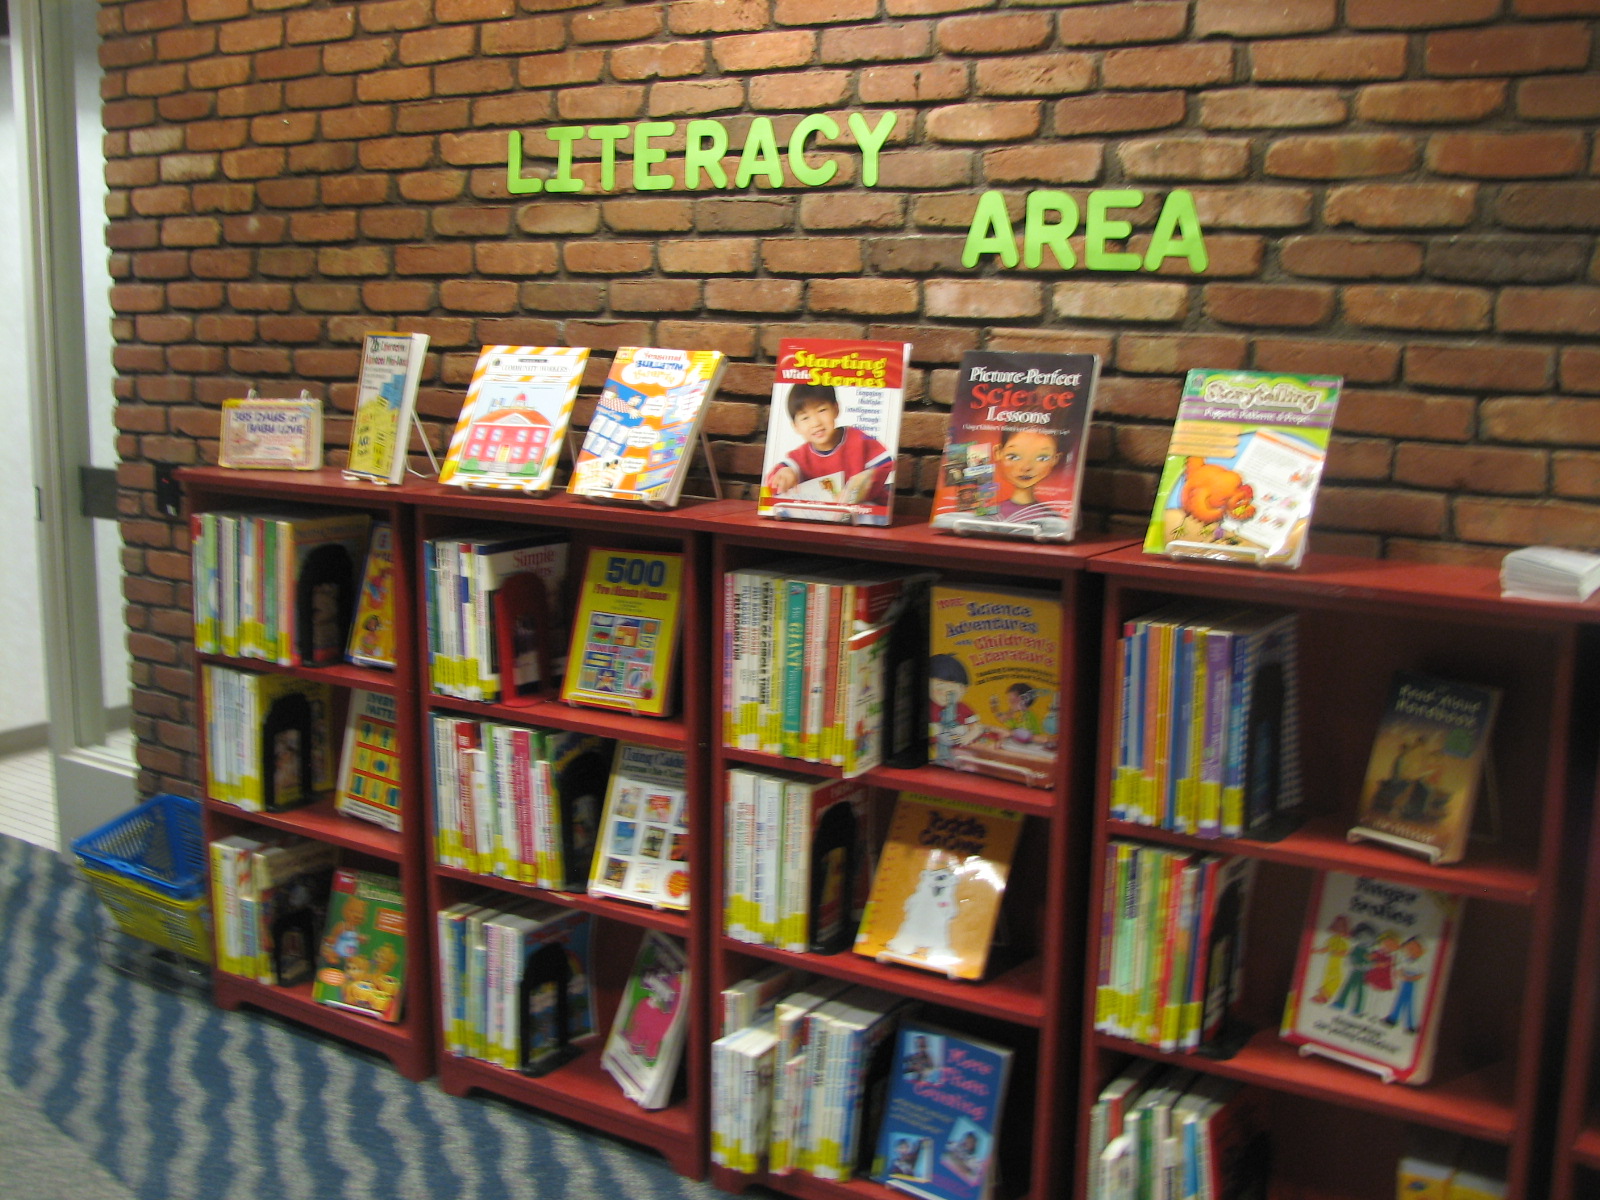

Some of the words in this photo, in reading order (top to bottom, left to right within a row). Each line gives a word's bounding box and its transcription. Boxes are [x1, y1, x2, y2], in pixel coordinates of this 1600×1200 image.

[506, 111, 898, 194] LITERACY
[961, 189, 1209, 273] AREA
[782, 368, 811, 381] With
[807, 367, 887, 389] Stories
[793, 350, 888, 378] Starting
[968, 365, 1082, 387] Picture-Perfect
[970, 383, 1075, 411] Science
[985, 405, 1052, 425] Lessons
[606, 557, 666, 587] 500
[967, 602, 1032, 617] Science
[946, 618, 1039, 638] Adventures
[787, 622, 803, 667] GIANT
